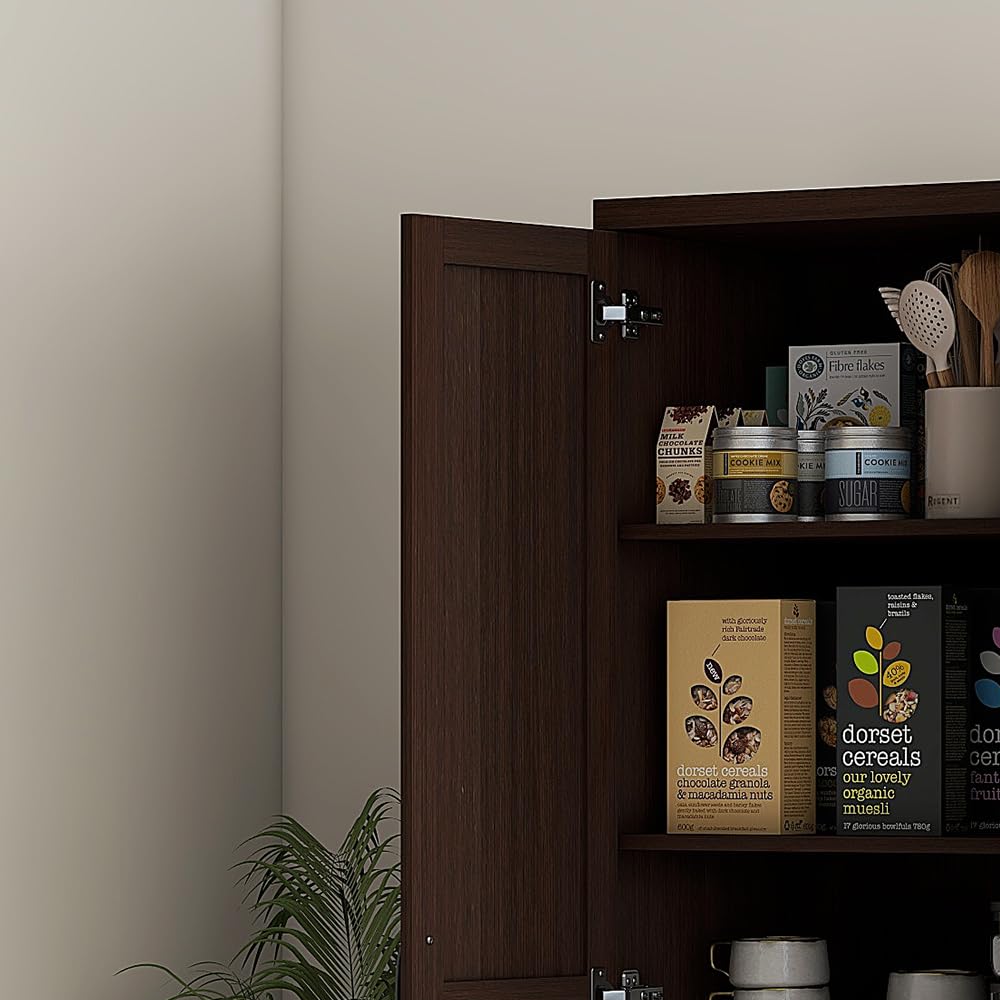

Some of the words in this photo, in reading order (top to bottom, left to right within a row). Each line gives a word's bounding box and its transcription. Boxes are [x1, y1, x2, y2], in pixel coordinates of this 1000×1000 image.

[829, 359, 854, 373] Fibre
[856, 358, 885, 372] flakes
[658, 446, 703, 456] CHUNKS
[730, 459, 764, 467] COOKIE
[765, 459, 782, 467] MIX
[798, 462, 814, 470] KIE
[864, 458, 896, 467] COOKIE
[838, 480, 878, 507] SUGAR
[887, 601, 911, 609] raisins
[911, 601, 918, 609] &
[705, 661, 721, 681] new
[886, 664, 905, 679] 40%
[842, 724, 913, 744] dorset
[842, 747, 922, 767] cereals
[676, 764, 718, 777] dorset
[721, 764, 769, 777] cereals
[676, 777, 727, 789] chocolate
[729, 777, 771, 790] granola
[842, 773, 868, 784] our
[870, 770, 912, 785] lovely
[676, 789, 687, 801] &
[688, 789, 748, 801] macadamia
[749, 790, 774, 801] nuts
[842, 786, 895, 802] organic
[842, 803, 890, 816] muesli
[843, 822, 851, 830] 17
[852, 822, 881, 831] glorious
[881, 822, 912, 830] bowlfuls
[912, 822, 931, 832] 780g
